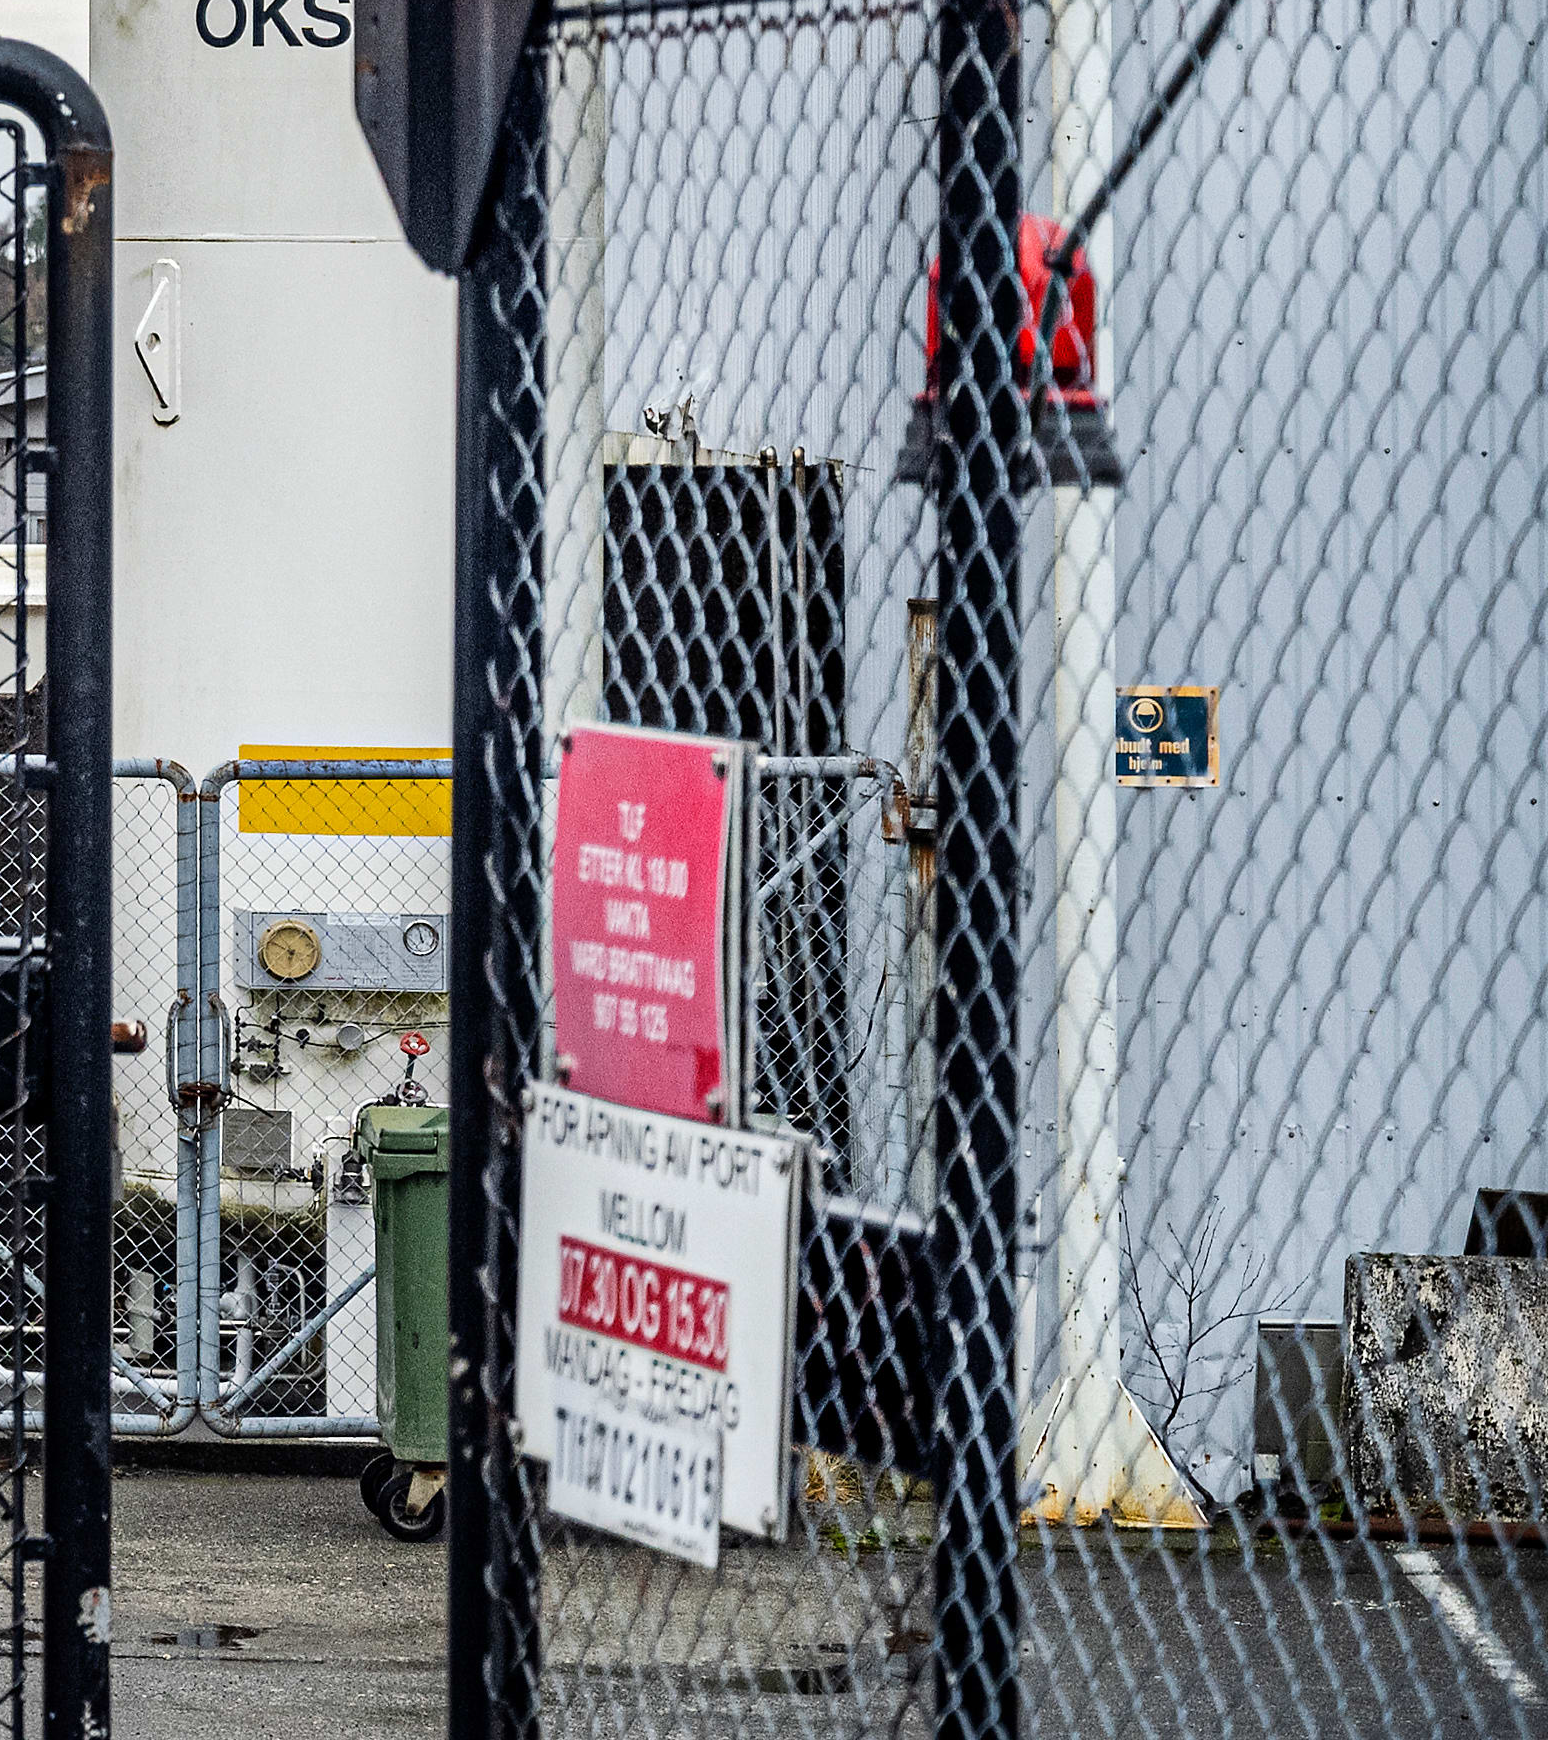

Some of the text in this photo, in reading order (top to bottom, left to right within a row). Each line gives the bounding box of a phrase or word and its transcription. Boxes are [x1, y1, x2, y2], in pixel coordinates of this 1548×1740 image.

[1159, 736, 1191, 754] med
[540, 1096, 581, 1150] FOR
[662, 1129, 694, 1180] AV
[699, 1137, 764, 1198] PORT
[598, 1189, 687, 1255] MELLOM
[620, 1262, 661, 1341] OG
[544, 1326, 630, 1398] MANDAG
[651, 1358, 741, 1431] FREDAG
